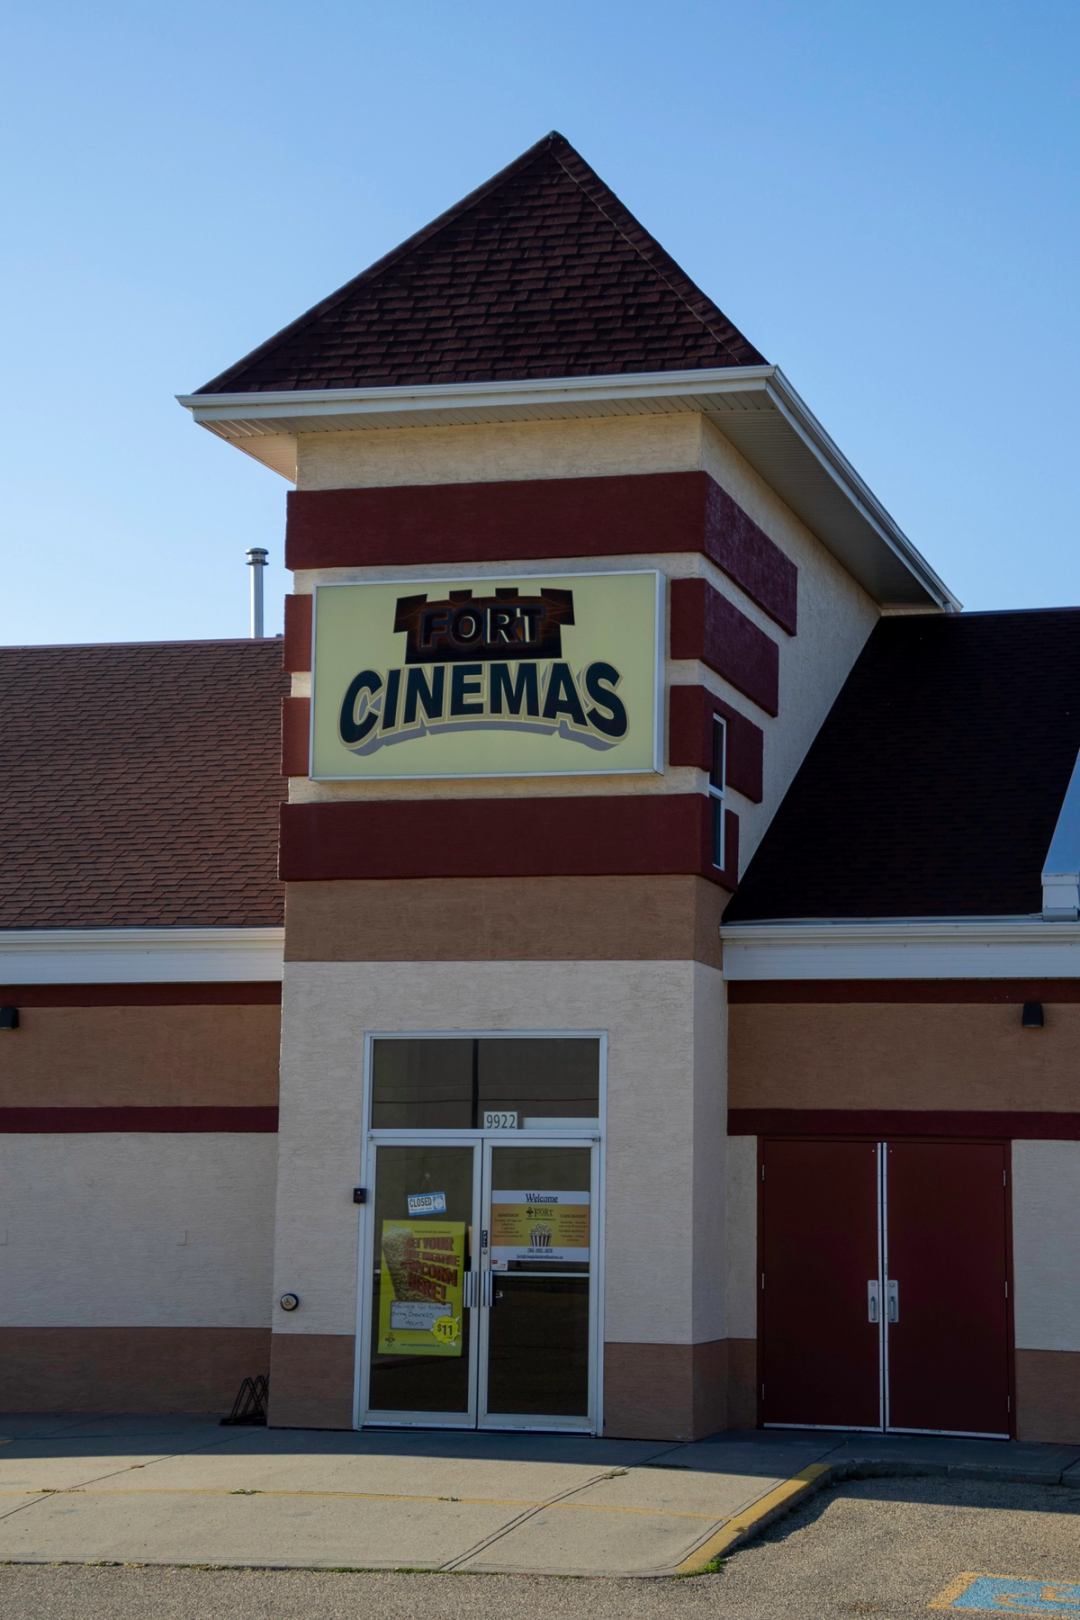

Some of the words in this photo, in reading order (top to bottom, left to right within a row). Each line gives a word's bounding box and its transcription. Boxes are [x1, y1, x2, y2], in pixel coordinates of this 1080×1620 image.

[419, 606, 546, 649] FORT
[338, 661, 628, 744] CINEMAS
[486, 1113, 516, 1129] 9922
[409, 1196, 432, 1208] CLOSED
[525, 1192, 559, 1204] Welcome
[437, 1323, 453, 1336] $11
